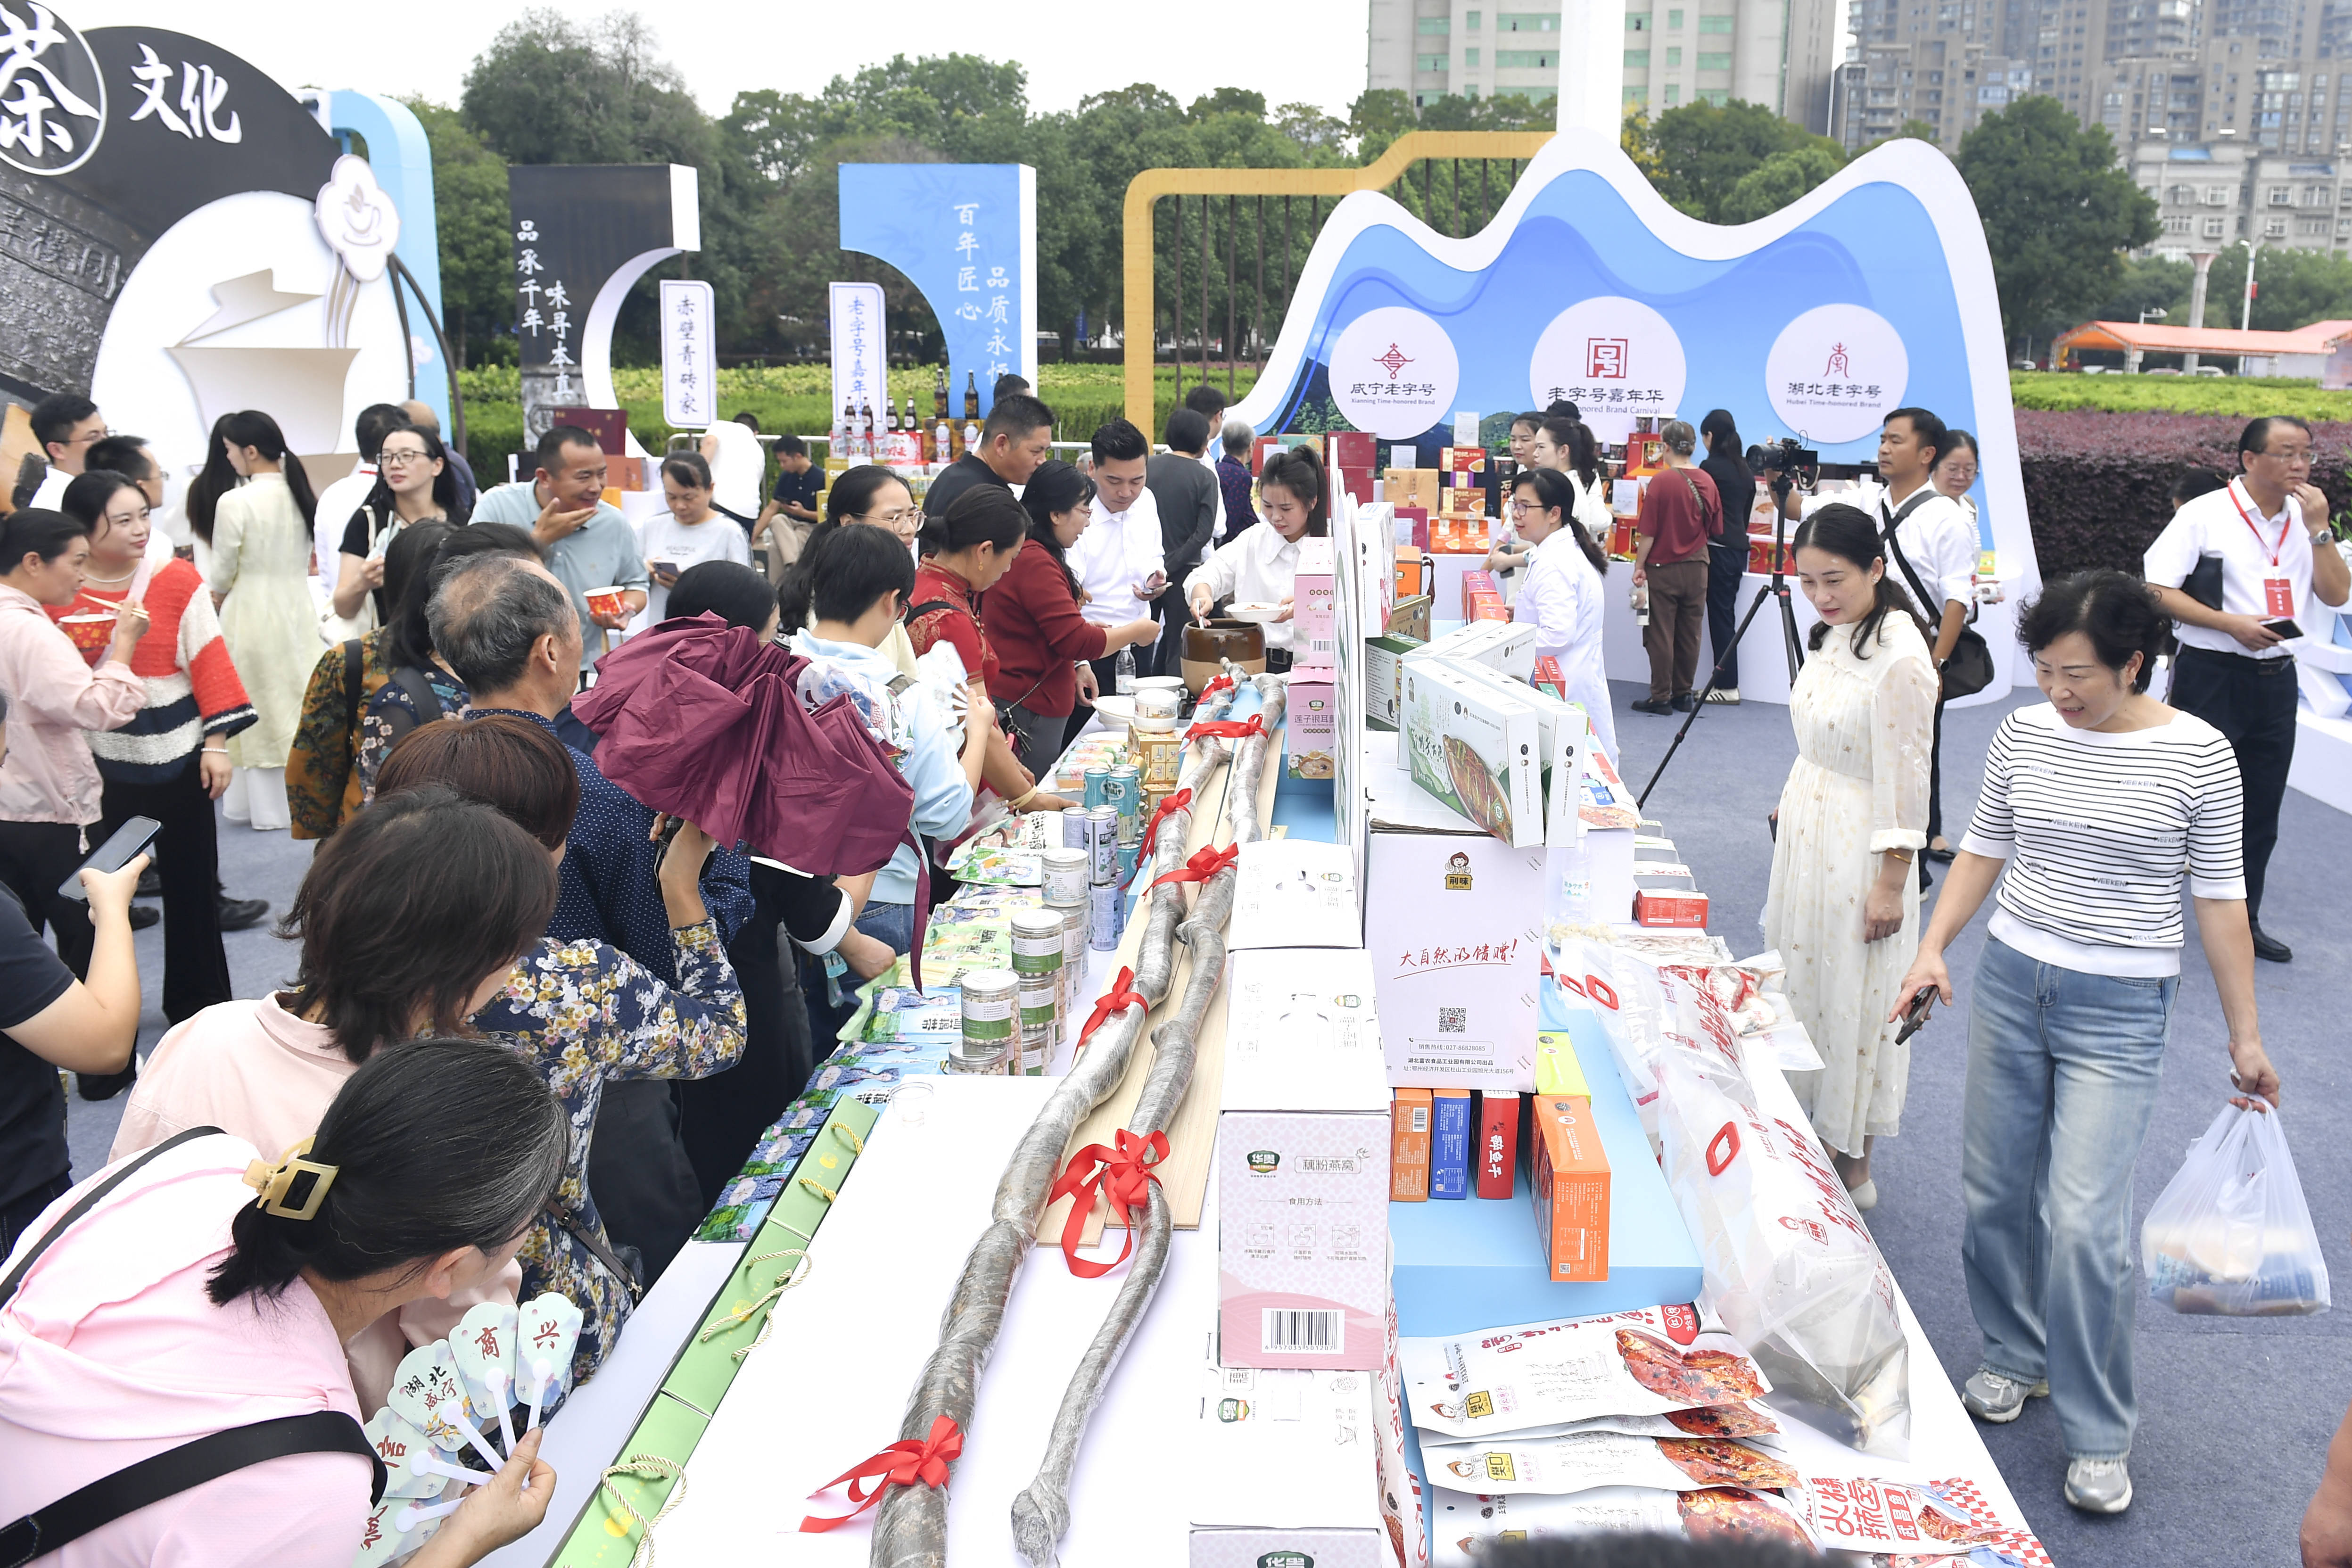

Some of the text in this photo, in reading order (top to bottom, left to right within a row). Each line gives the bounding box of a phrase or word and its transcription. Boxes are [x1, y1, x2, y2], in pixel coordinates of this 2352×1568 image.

[0, 1, 242, 157] 茶 文化
[954, 203, 982, 321] 百年匠心
[516, 220, 545, 338] 品承千年
[545, 280, 576, 402] 味寻本真
[1350, 382, 1436, 397] 咸宁老字号
[1548, 386, 1665, 404] 老字号嘉年华
[1787, 382, 1882, 399] 湖北老字号
[1809, 399, 1857, 407] Time-honored
[1630, 406, 1660, 414] Carnival
[1449, 876, 1469, 886] 荆味
[1399, 939, 1518, 967] 大自然的馈赠！
[1252, 1154, 1275, 1164] 华贵
[1303, 1159, 1354, 1172] 藕粉燕窝
[1288, 1197, 1322, 1206] 食用方法
[475, 1326, 500, 1361] 商
[533, 1319, 560, 1349] 兴
[405, 1366, 447, 1399] 湖北
[423, 1378, 457, 1411] 咸宁
[1811, 1478, 1855, 1536] 火爆
[1888, 1494, 1917, 1539] 武昌鱼
